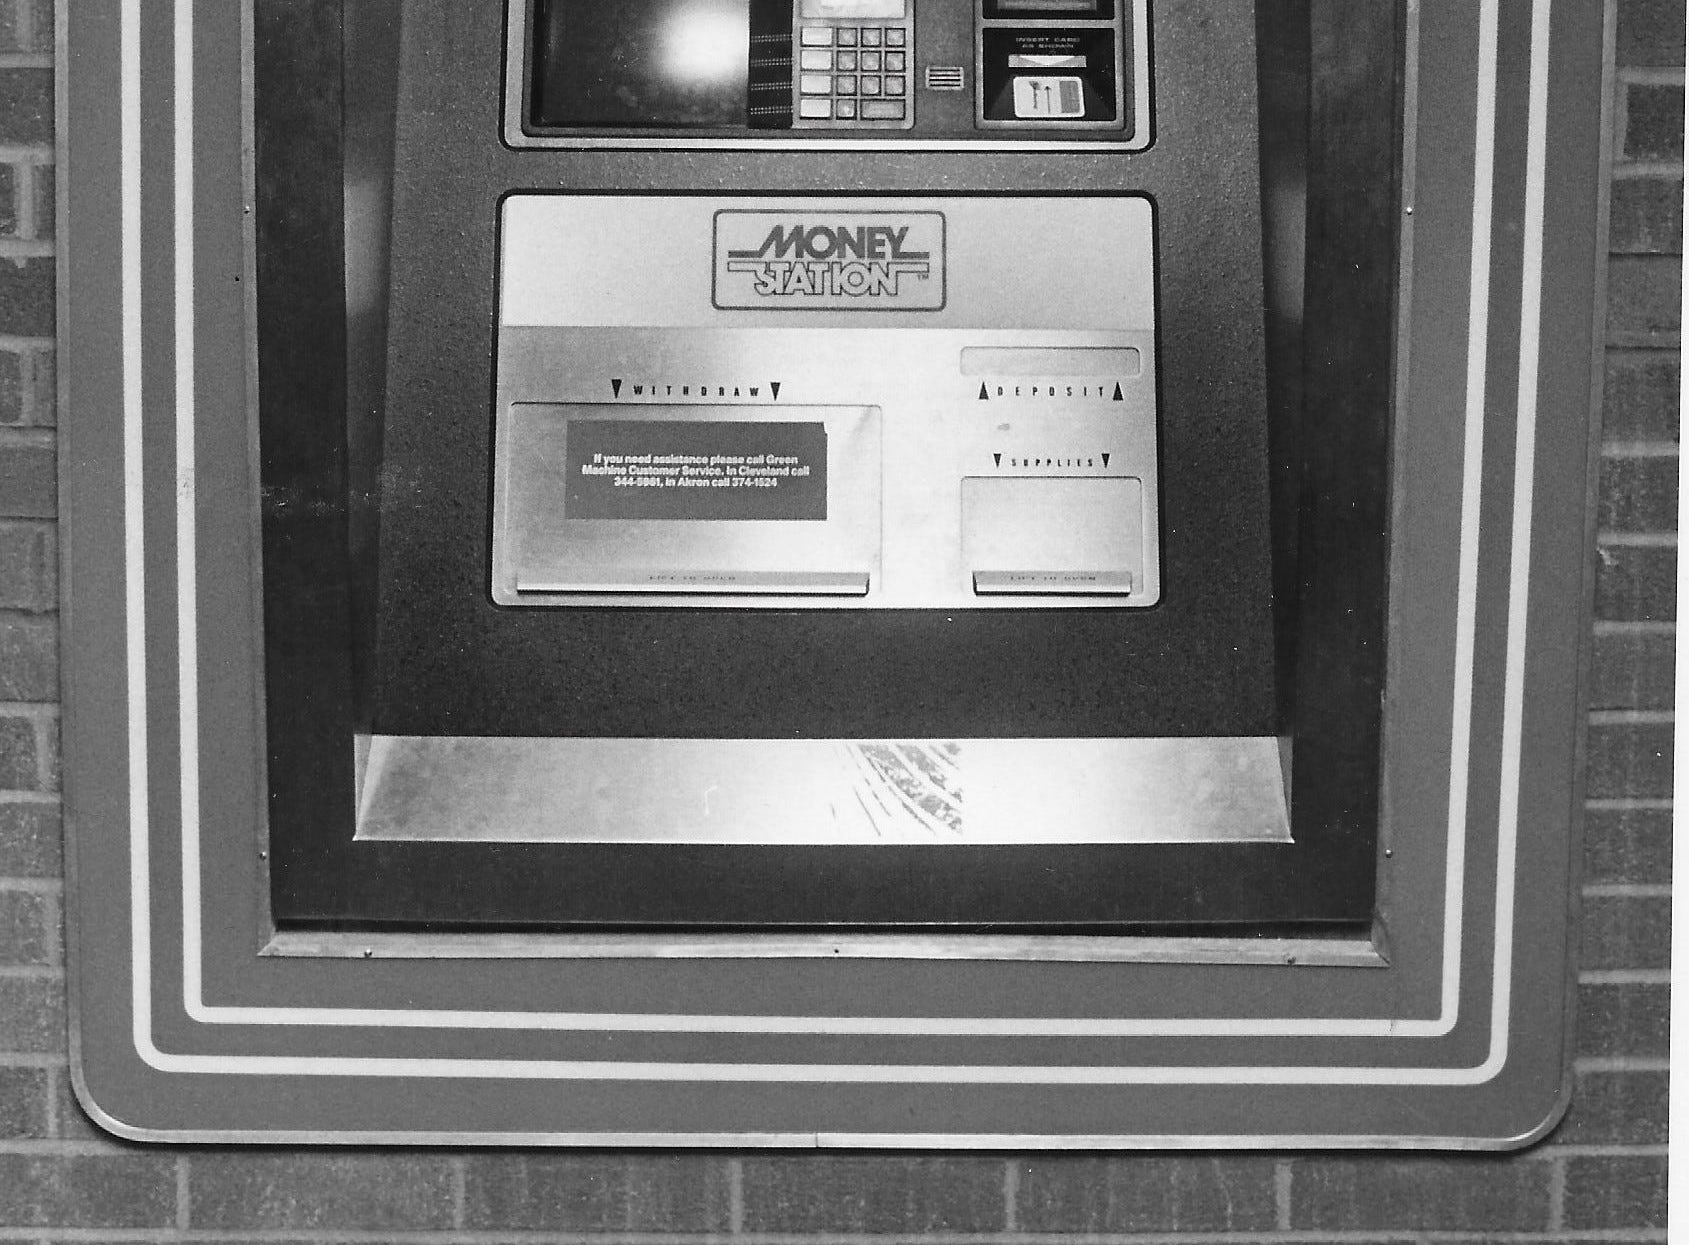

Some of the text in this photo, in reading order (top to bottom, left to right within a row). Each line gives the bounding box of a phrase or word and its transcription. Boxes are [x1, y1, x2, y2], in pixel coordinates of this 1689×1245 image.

[757, 224, 909, 259] MONEY
[754, 261, 899, 297] STATION
[633, 385, 759, 397] WITHDRAW
[997, 386, 1104, 397] DEPOSIT
[603, 455, 623, 466] you
[624, 454, 651, 464] need
[652, 454, 709, 464] assistance
[710, 455, 745, 466] please
[746, 454, 765, 464] call
[766, 454, 799, 465] Green
[1011, 458, 1093, 468] SUPPLIES
[581, 464, 627, 475] Machine
[628, 464, 680, 475] Customer
[738, 465, 789, 476] Cleveland
[790, 465, 810, 476] call
[677, 477, 710, 487] Akron
[711, 477, 730, 487] call
